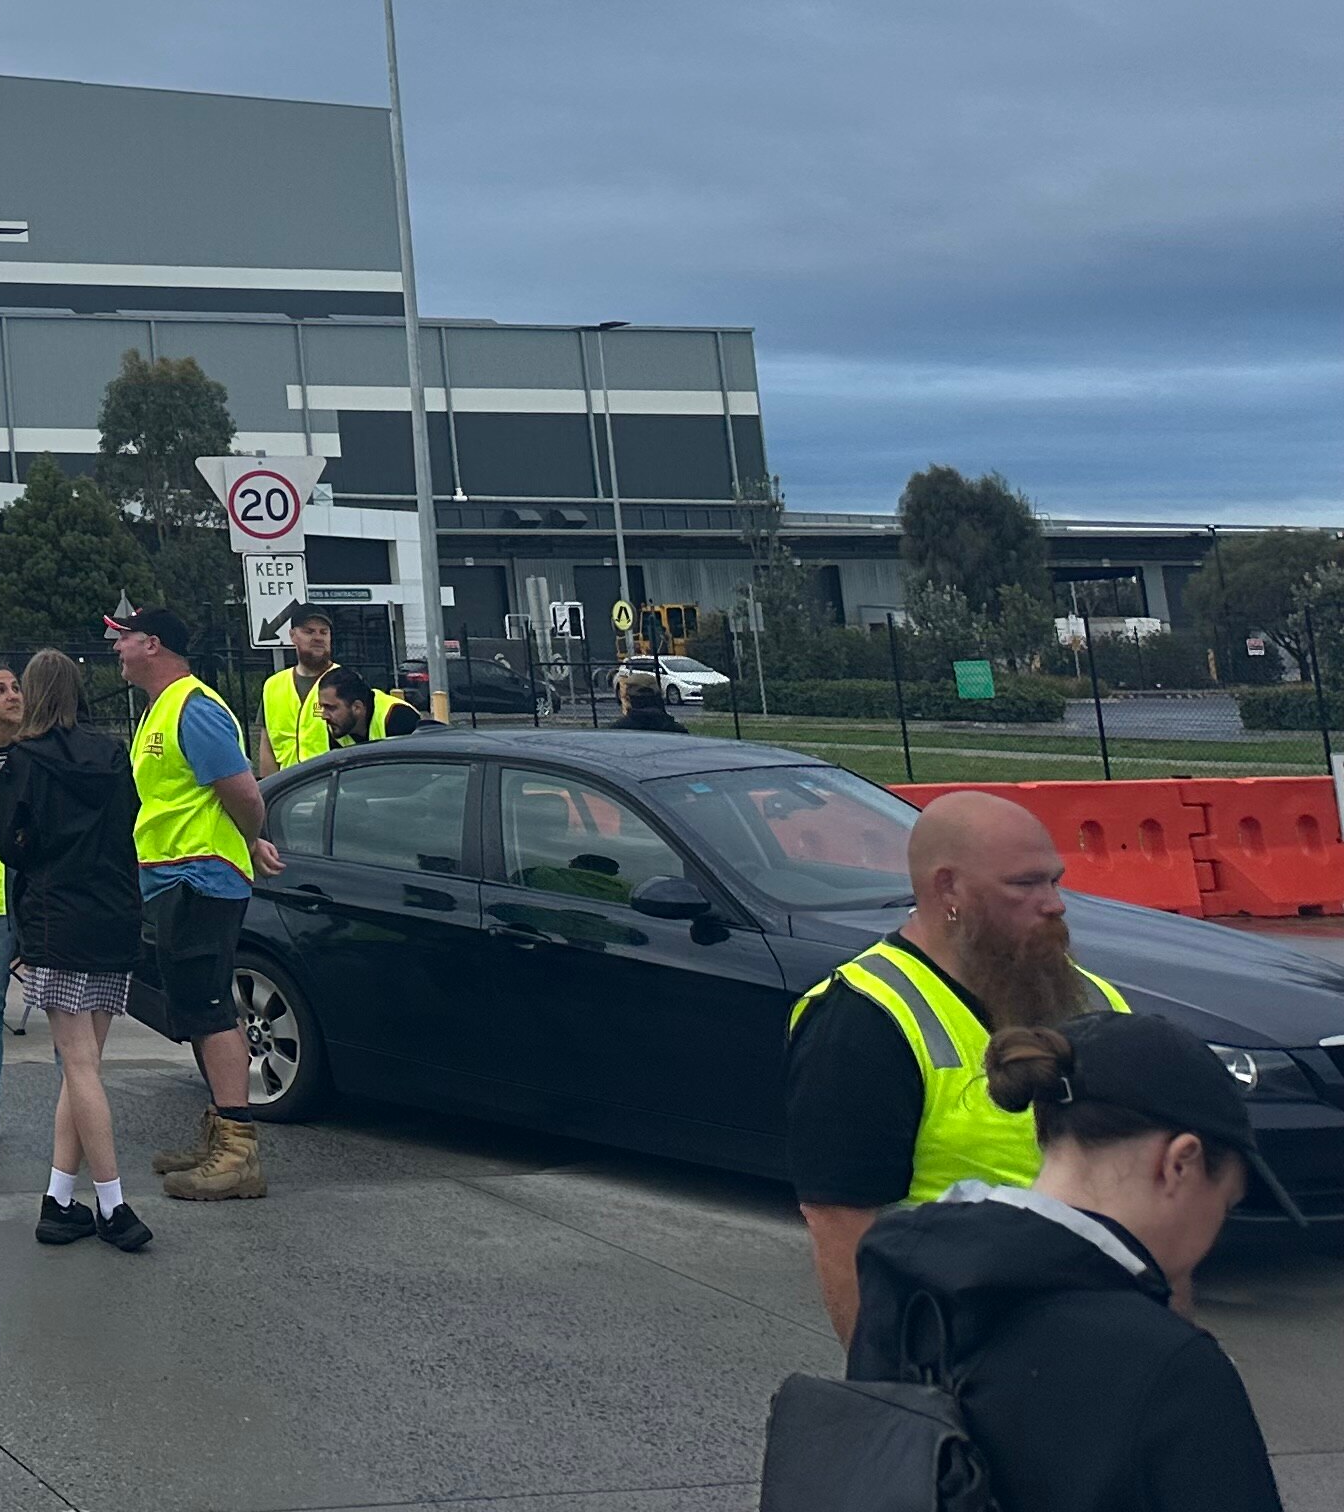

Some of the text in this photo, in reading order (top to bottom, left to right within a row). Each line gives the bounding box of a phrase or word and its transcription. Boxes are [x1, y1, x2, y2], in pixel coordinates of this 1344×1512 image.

[238, 487, 289, 522] 20
[255, 562, 295, 577] KEEP
[258, 581, 294, 596] LEFT
